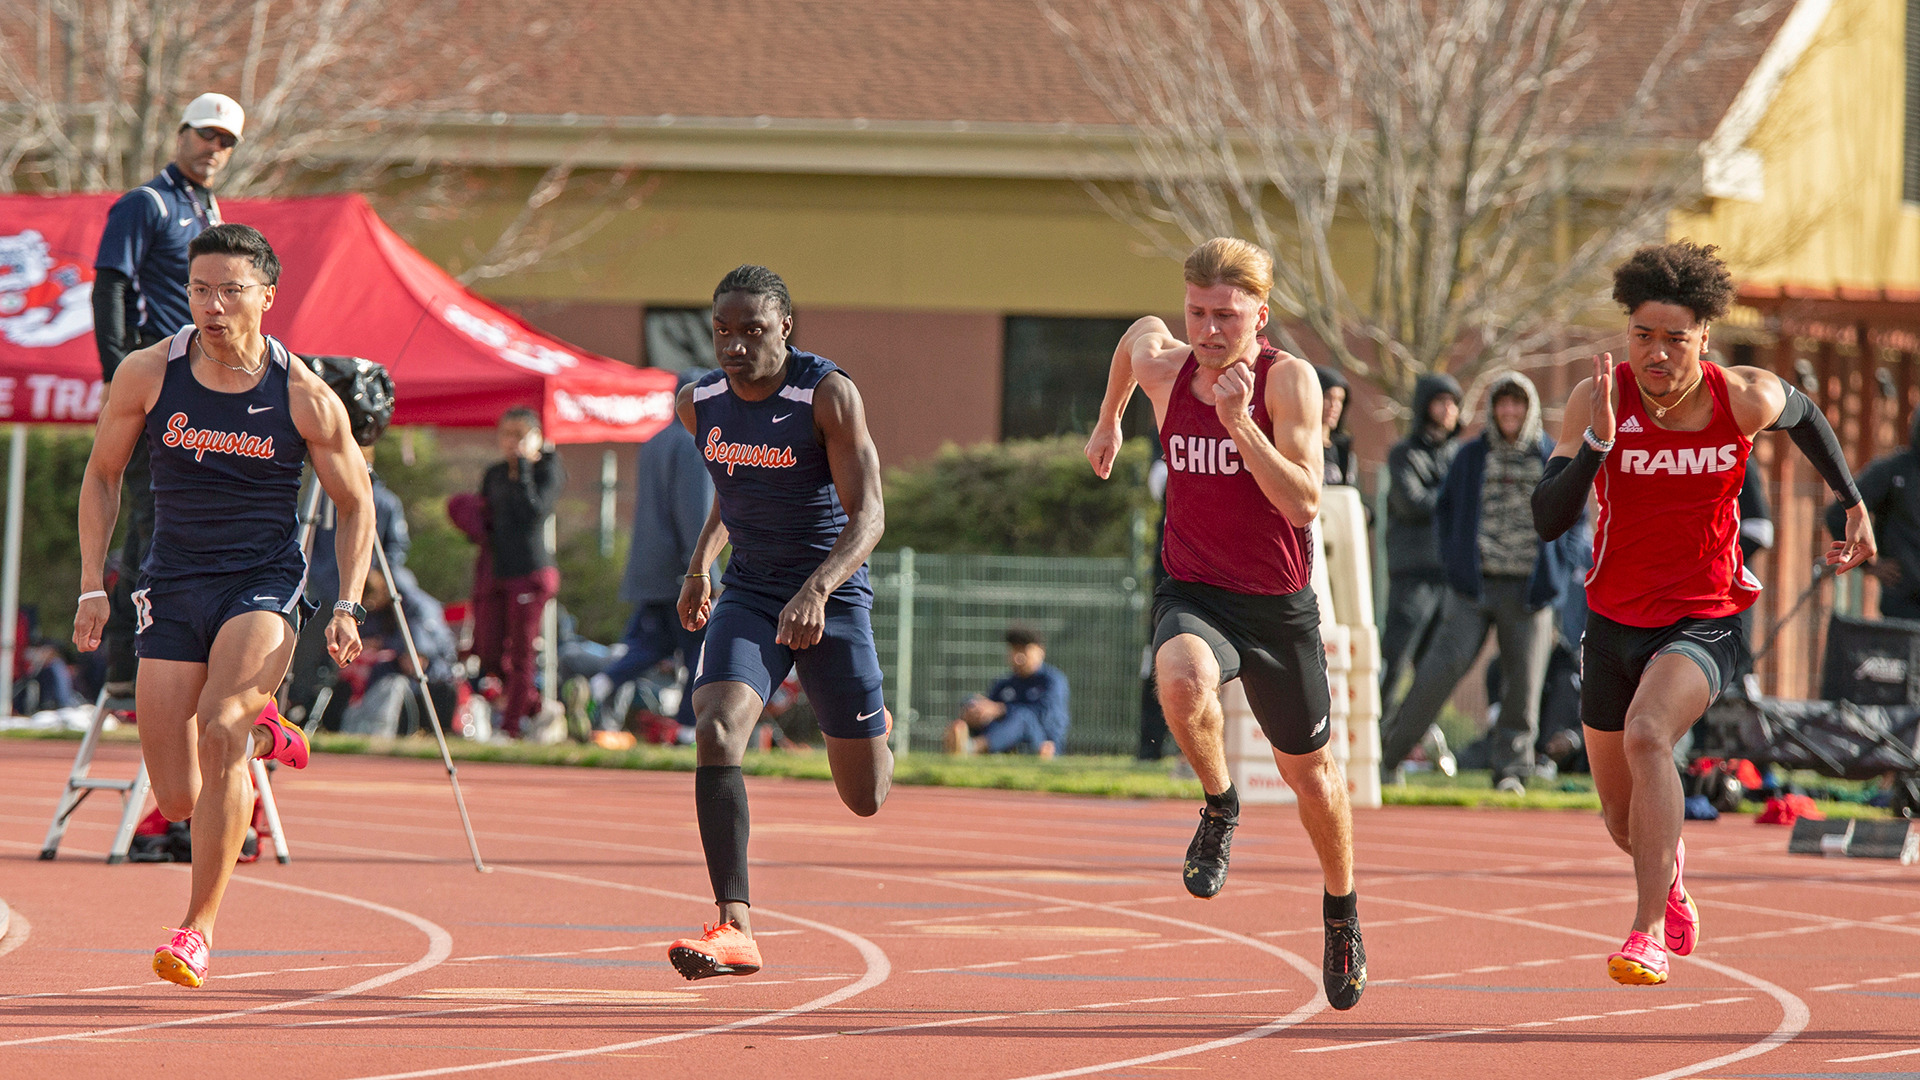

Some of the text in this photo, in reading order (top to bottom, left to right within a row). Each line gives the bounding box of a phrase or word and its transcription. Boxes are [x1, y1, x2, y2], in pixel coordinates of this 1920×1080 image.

[162, 411, 276, 462] Sequoias
[704, 426, 798, 476] Sequoias
[1168, 433, 1252, 475] CHIC
[1620, 443, 1737, 475] RAMS
